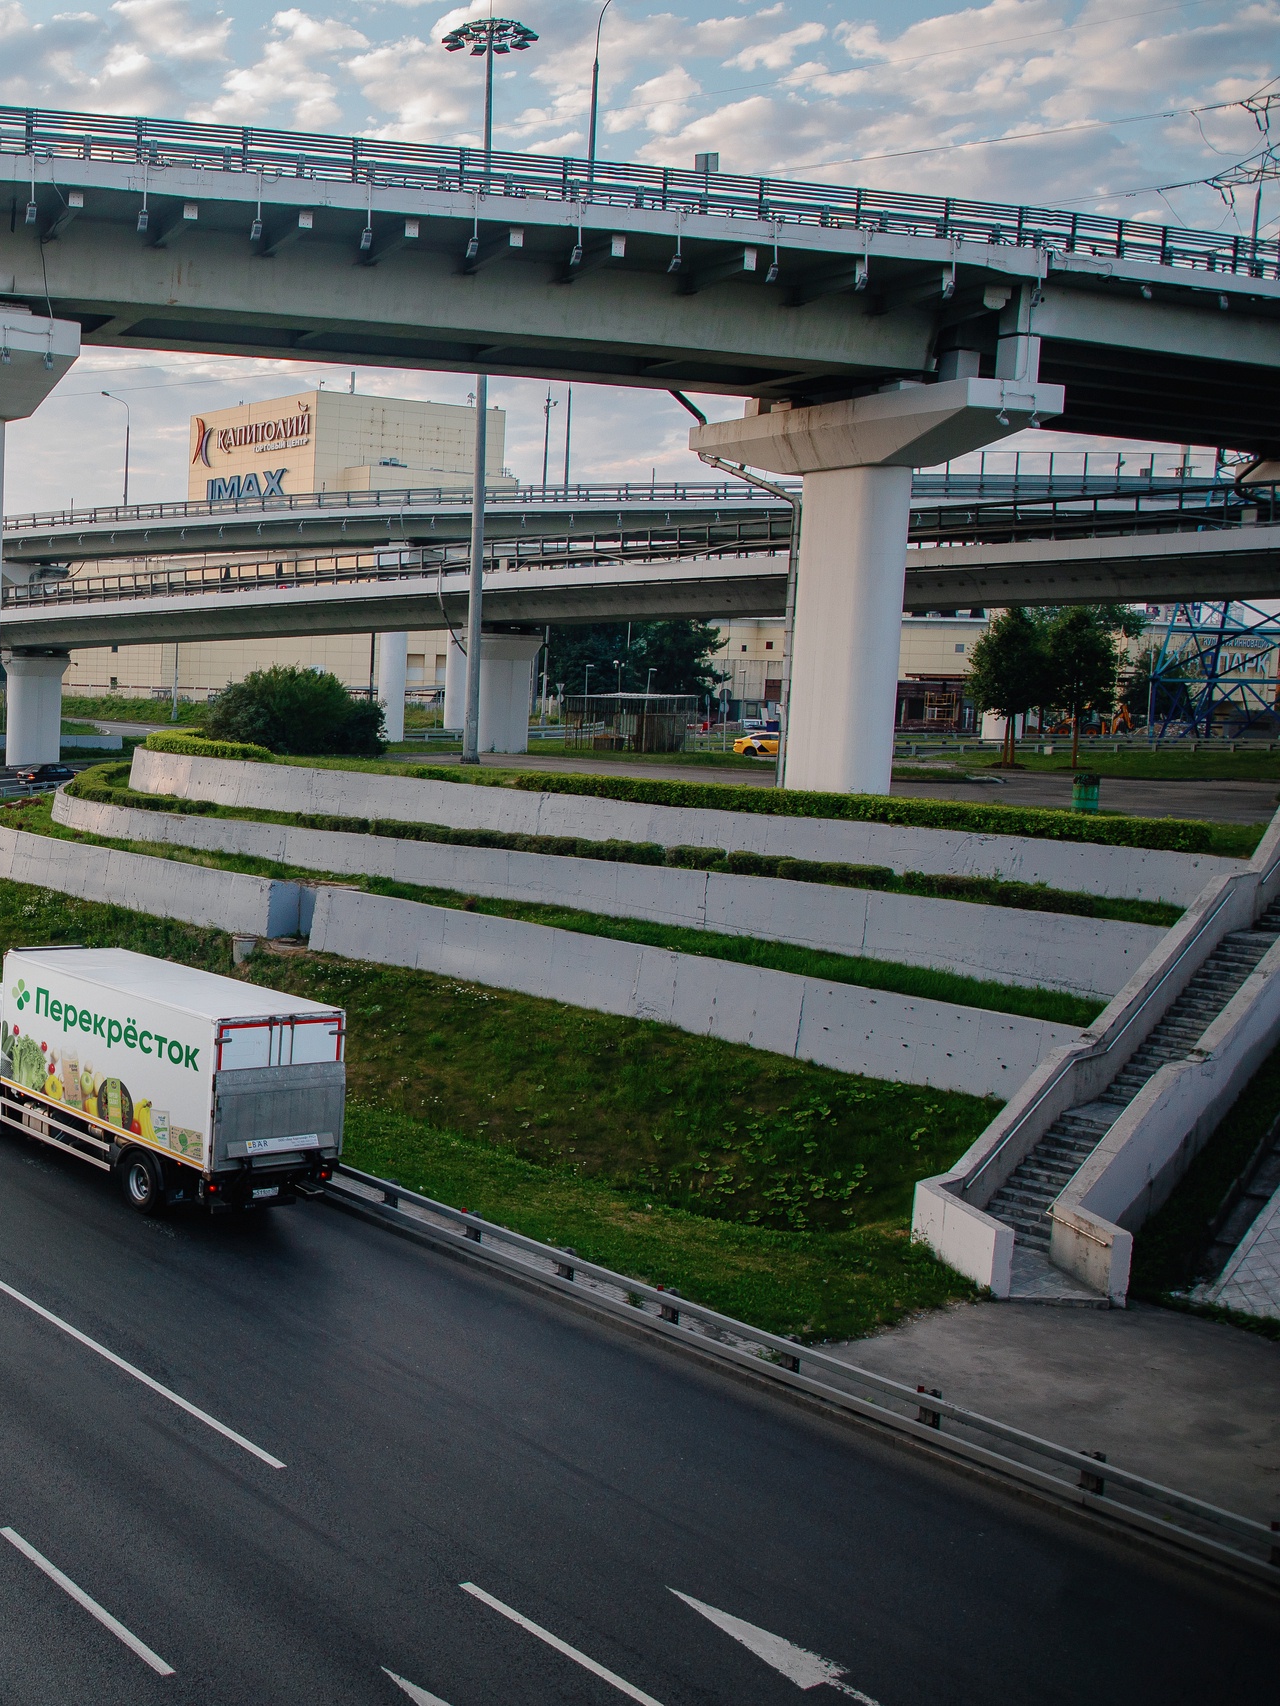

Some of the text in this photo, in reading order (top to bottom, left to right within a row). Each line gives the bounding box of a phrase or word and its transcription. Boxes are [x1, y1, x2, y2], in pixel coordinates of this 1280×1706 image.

[217, 402, 310, 454] КАПИТОЛИЙ
[253, 438, 308, 452] ТОРГОВЫЙ ЦЕНТР
[207, 469, 285, 500] IMAX
[35, 986, 201, 1072] Перекрёсток
